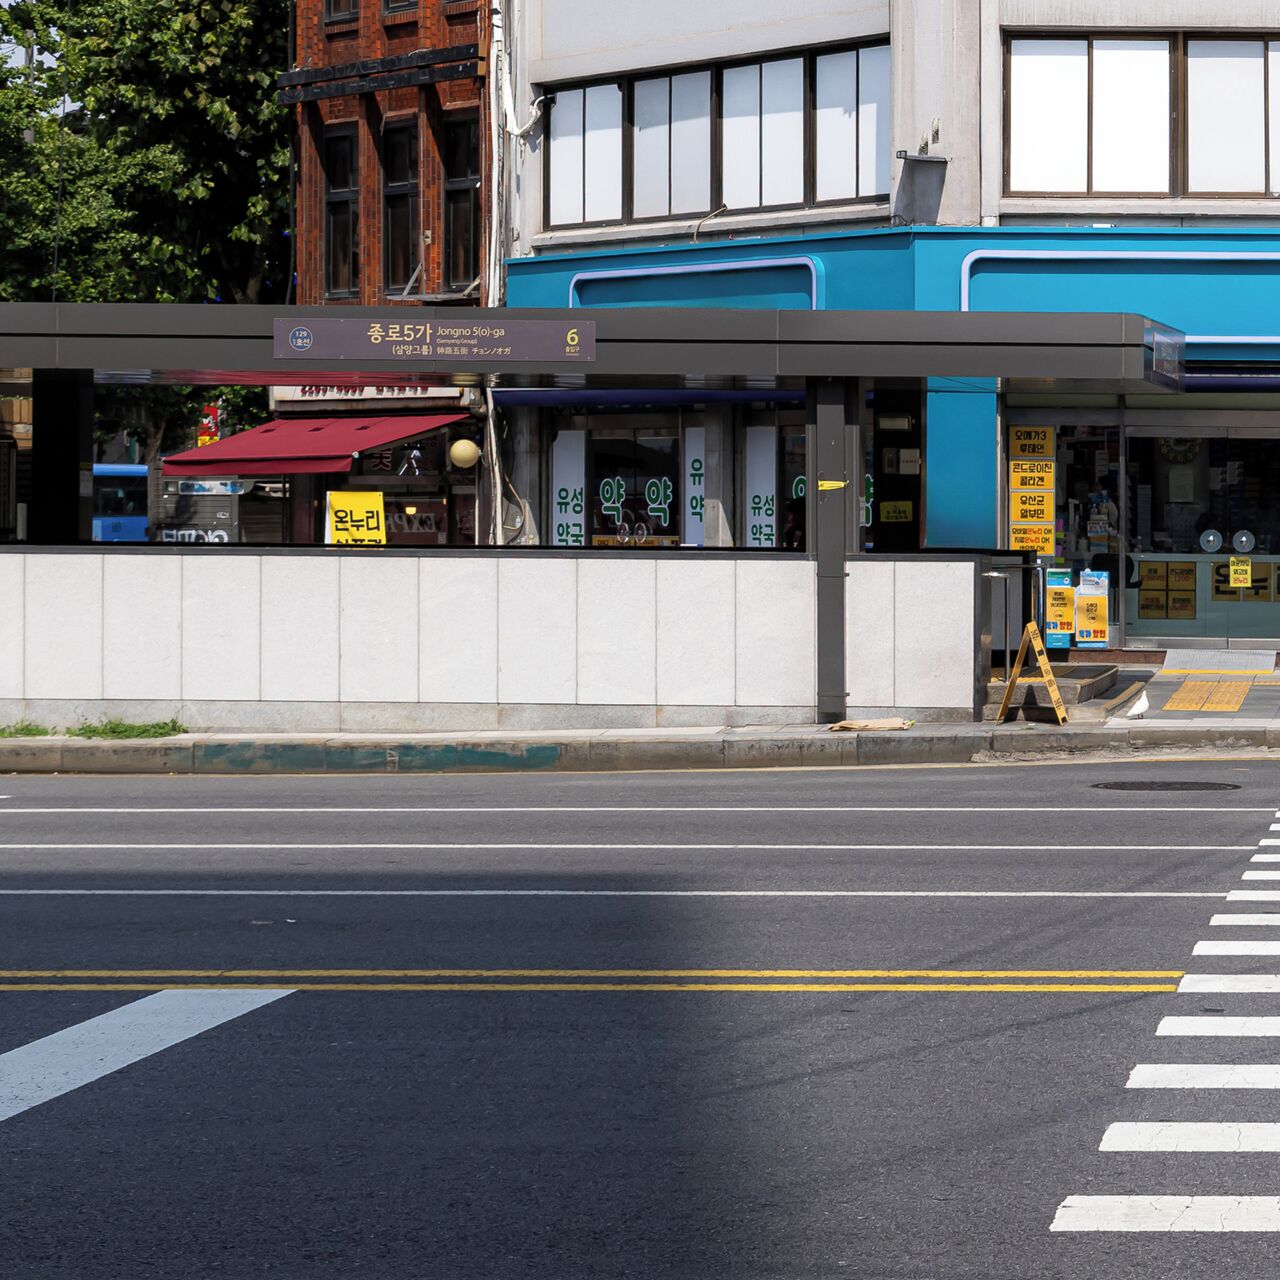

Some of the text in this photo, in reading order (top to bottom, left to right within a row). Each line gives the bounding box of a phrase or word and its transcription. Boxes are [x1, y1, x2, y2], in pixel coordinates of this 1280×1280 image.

[367, 323, 433, 344] 종로5가
[436, 326, 505, 338] Jongno 5(o)-ga
[566, 328, 579, 345] 6
[392, 344, 433, 356] (삼양그룹)
[472, 346, 512, 355] チョンノオガ
[1015, 430, 1047, 441] 오메가3
[1020, 443, 1045, 454] 루테인
[690, 458, 704, 486] 유
[1012, 462, 1052, 473] 콘드로이친
[1020, 475, 1045, 487] 콜라겐
[557, 486, 584, 514] 유성
[600, 476, 673, 527] 약 약
[752, 494, 775, 518] 유성
[1020, 495, 1045, 506] 유산균
[690, 494, 704, 523] 약
[1020, 508, 1045, 519] 알부민
[334, 509, 380, 532] 온누리
[557, 522, 584, 545] 약국
[752, 523, 775, 546] 약국
[1043, 527, 1053, 535] OK
[1040, 536, 1050, 544] OK
